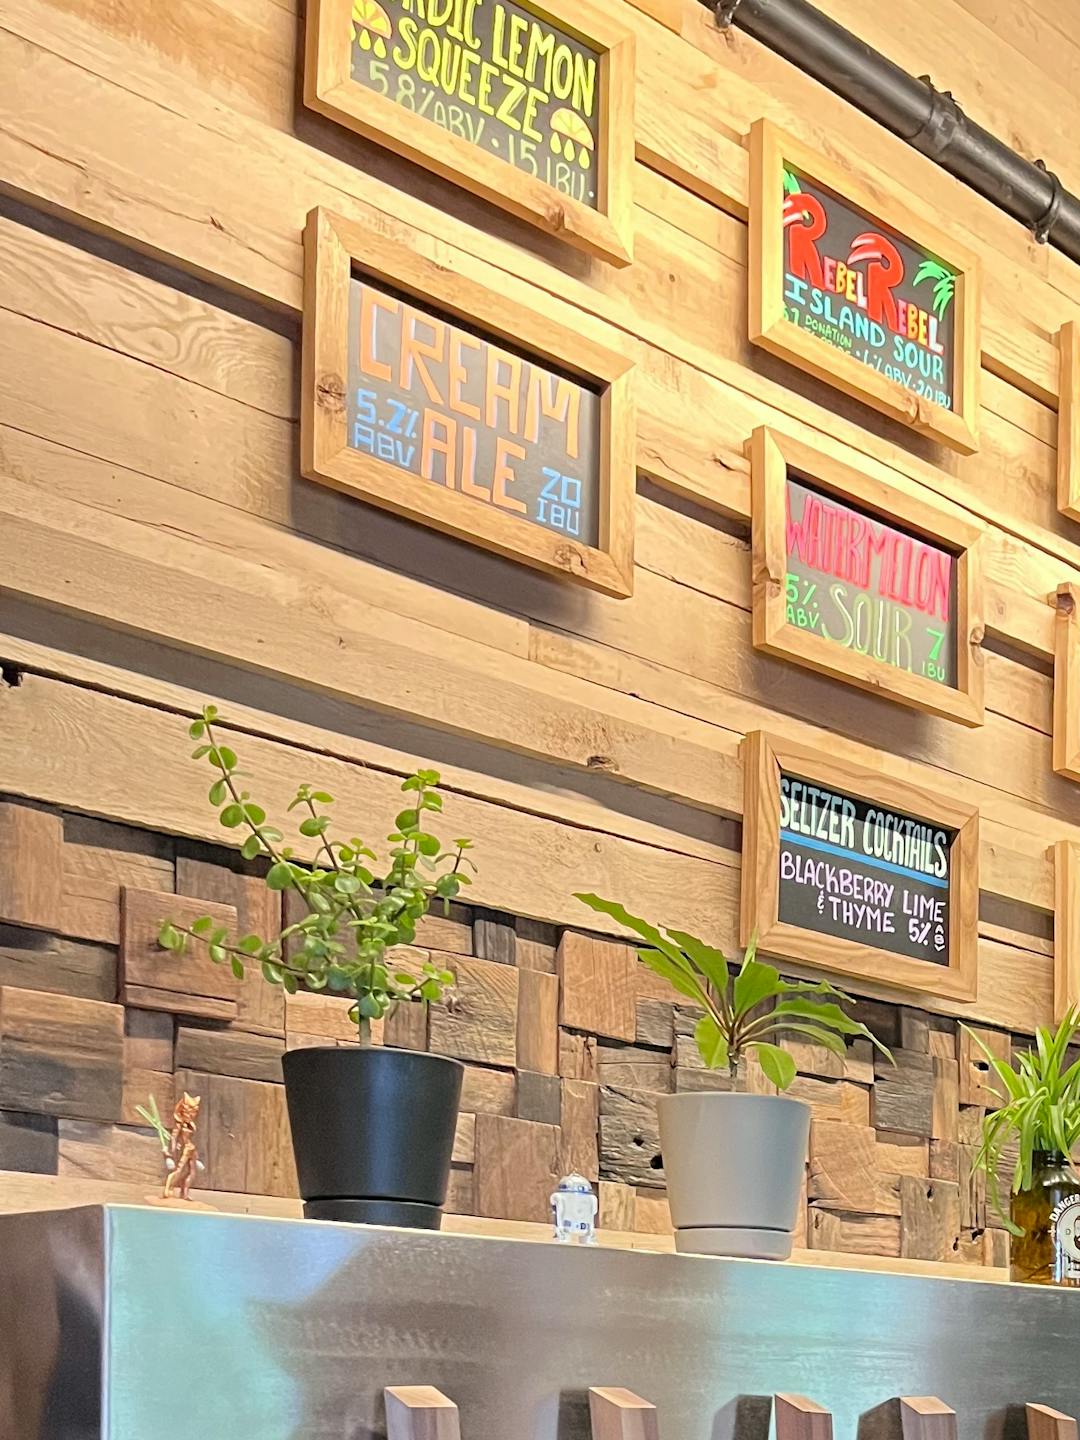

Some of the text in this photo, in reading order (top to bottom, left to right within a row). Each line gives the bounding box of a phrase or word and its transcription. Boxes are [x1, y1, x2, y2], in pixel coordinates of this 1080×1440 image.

[393, 17, 549, 143] SQUEEZE
[492, 4, 596, 117] LEMON
[508, 134, 538, 177] 15
[784, 273, 886, 348] ISLAND
[893, 335, 944, 384] SOUR
[805, 315, 852, 348] DONATION
[359, 287, 582, 459] CREAM
[354, 422, 415, 468] ABV
[421, 408, 527, 514] ALE
[540, 466, 582, 508] 20
[536, 497, 580, 535] IBU
[786, 482, 951, 622] WATERMELON
[786, 573, 818, 609] 5%
[786, 608, 820, 629] ABV
[821, 583, 912, 673] SOUR
[925, 628, 945, 661] 7
[922, 662, 946, 682] IBU
[780, 778, 948, 879] SELTZER COCKTAILS
[780, 851, 946, 923] BLACKBERRY LIME
[828, 895, 896, 933] THYME
[908, 918, 929, 946] 5%
